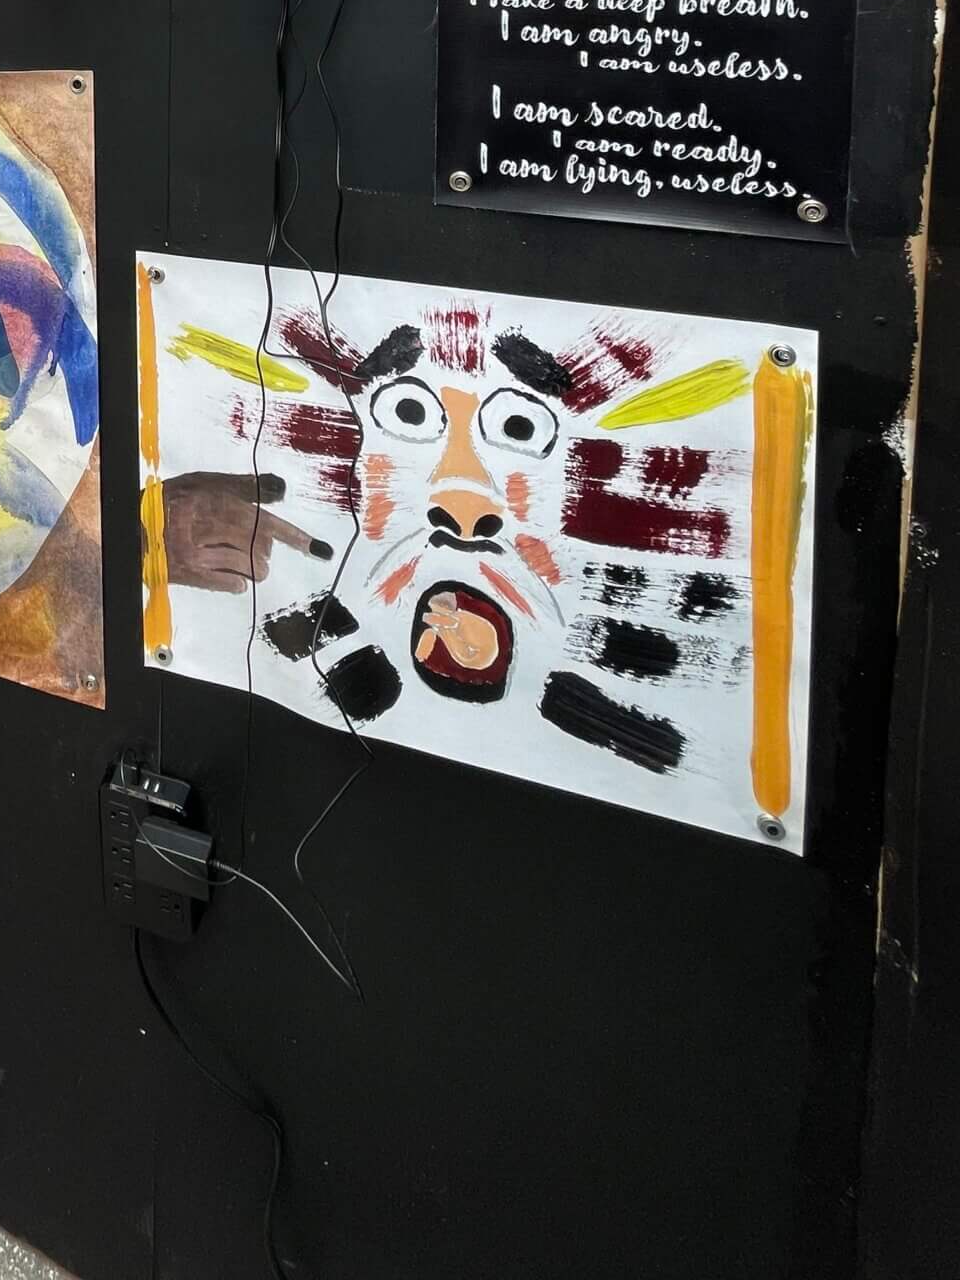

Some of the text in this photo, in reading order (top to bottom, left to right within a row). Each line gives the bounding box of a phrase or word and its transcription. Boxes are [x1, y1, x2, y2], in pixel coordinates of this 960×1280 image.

[501, 9, 704, 56] I am angry.
[580, 50, 803, 81] I am useless.
[492, 84, 723, 132] I am scared.
[480, 142, 812, 199] I am lying, useless.
[552, 129, 777, 177] I am ready.
